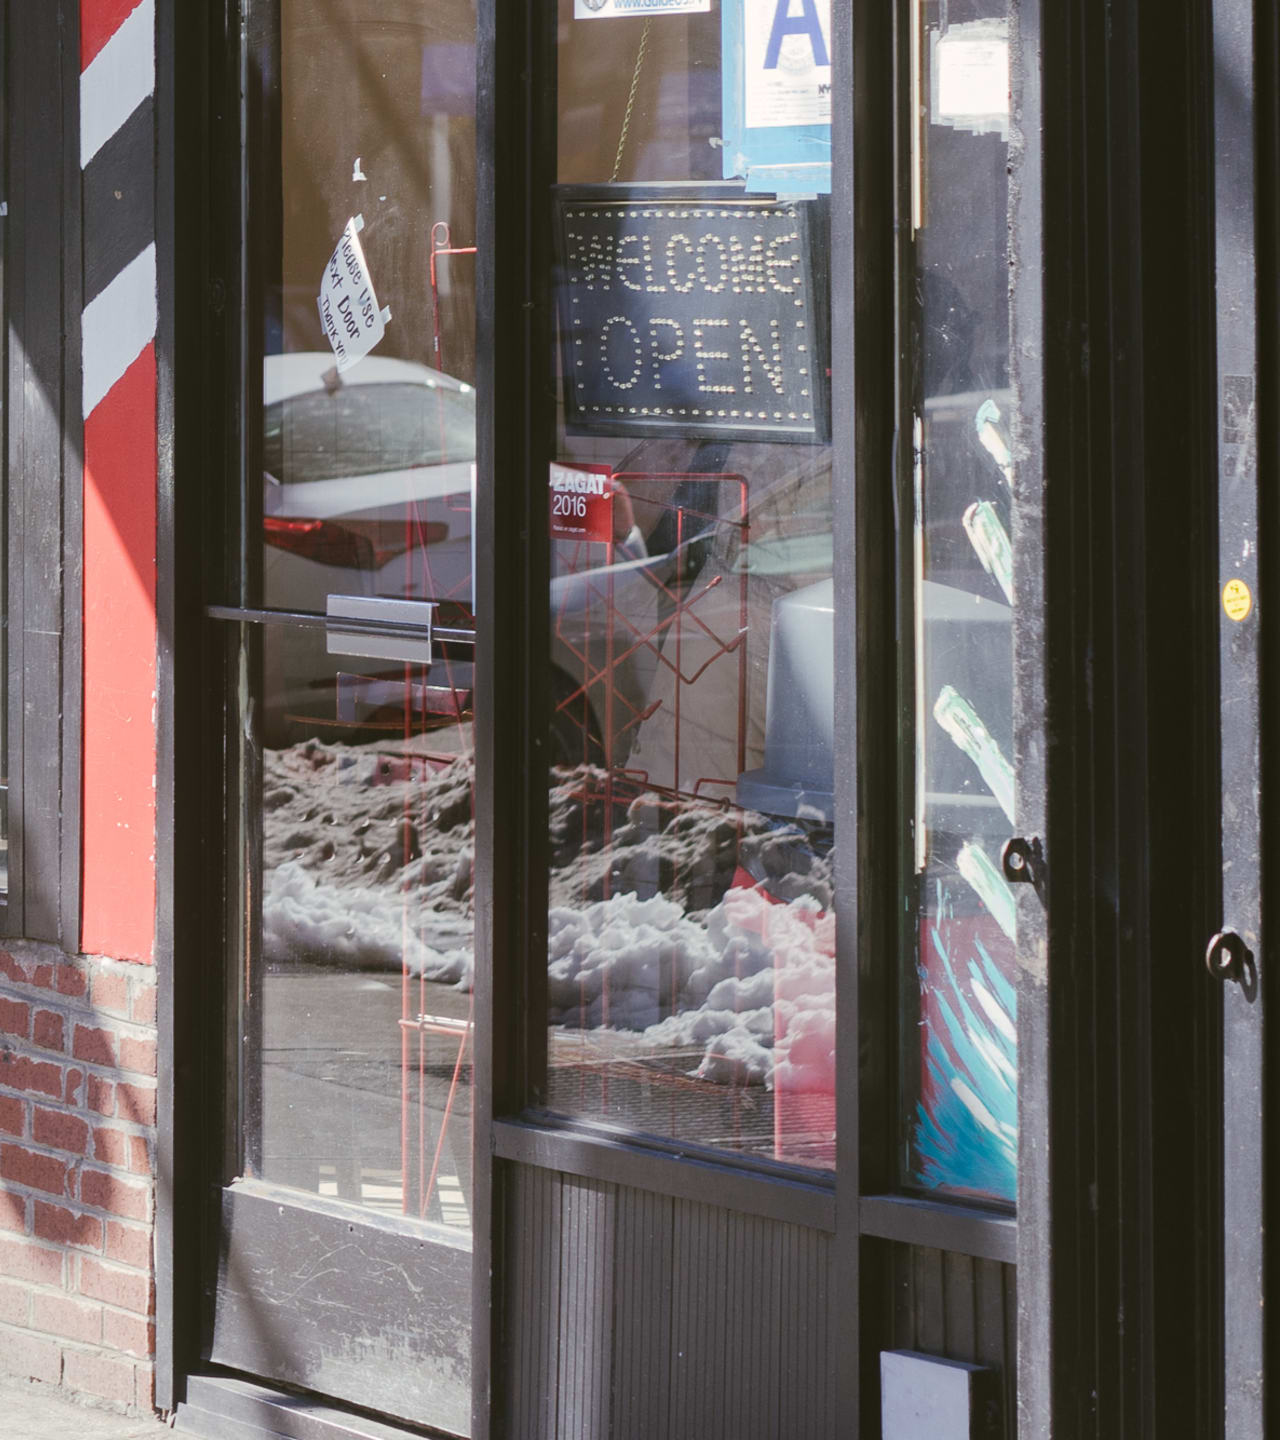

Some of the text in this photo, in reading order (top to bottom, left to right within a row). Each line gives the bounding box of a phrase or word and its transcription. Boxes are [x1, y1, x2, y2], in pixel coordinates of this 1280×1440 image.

[576, 232, 795, 293] WELCOME
[337, 295, 361, 340] Door
[599, 315, 785, 394] OPEN
[552, 494, 586, 517] 2016
[553, 472, 607, 494] ZAGAT
